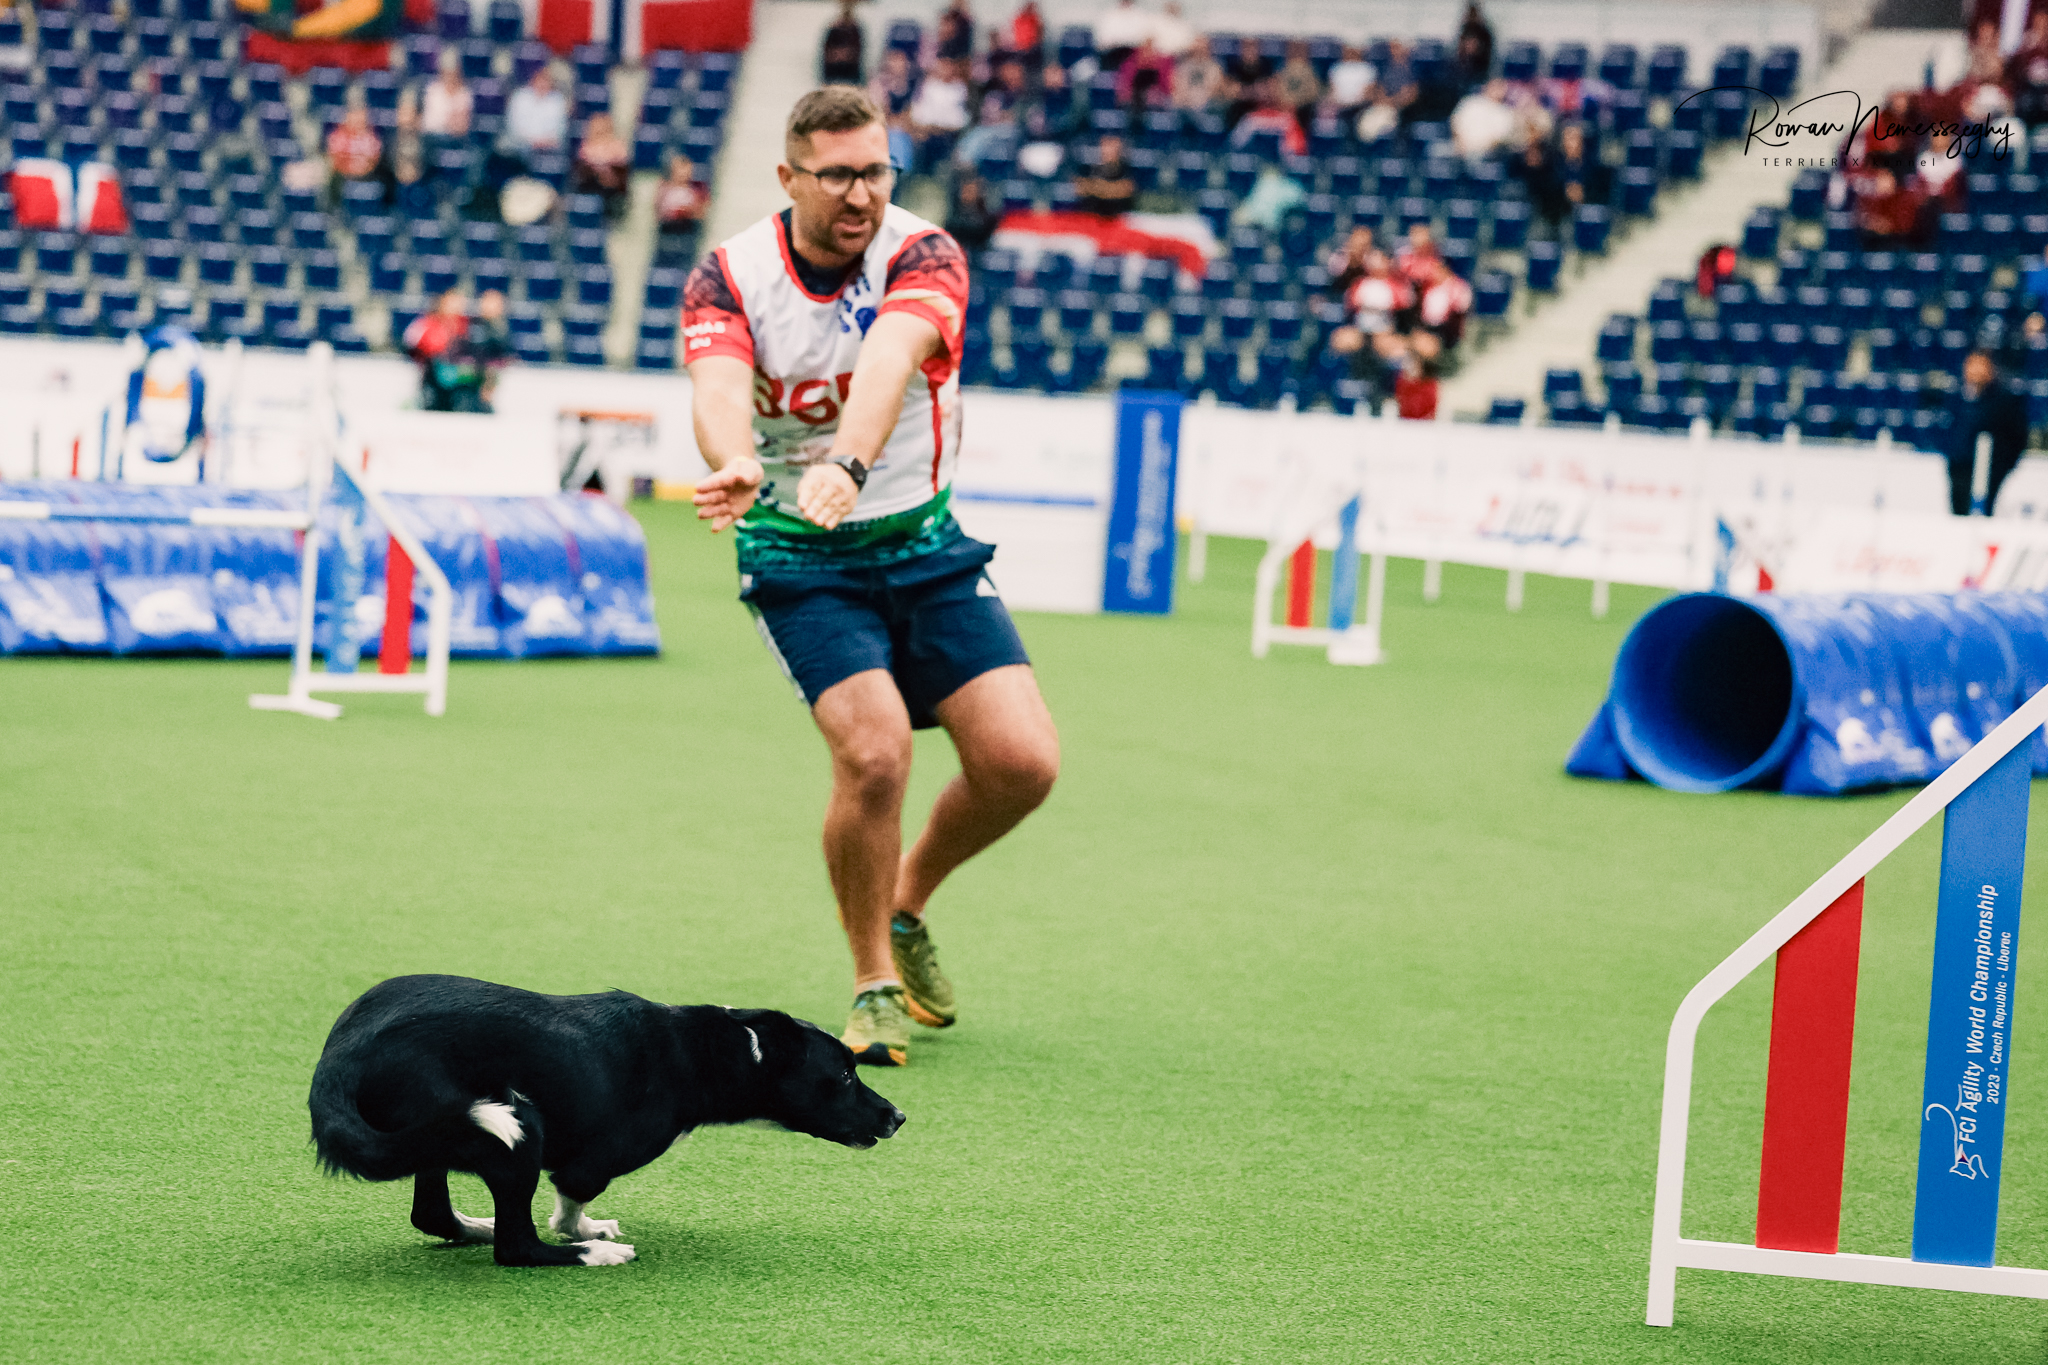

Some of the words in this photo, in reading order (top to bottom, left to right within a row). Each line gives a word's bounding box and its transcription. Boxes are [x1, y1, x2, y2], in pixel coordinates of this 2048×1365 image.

[1970, 884, 1999, 1002] Championship
[1996, 931, 2011, 972] Liberec
[1992, 981, 2008, 1029] Republic
[1966, 1006, 1986, 1053] World
[1989, 1031, 2003, 1064] Czech
[1961, 1061, 1984, 1113] Agility
[1987, 1074, 2000, 1104] 2023
[1959, 1116, 1977, 1143] FCI
